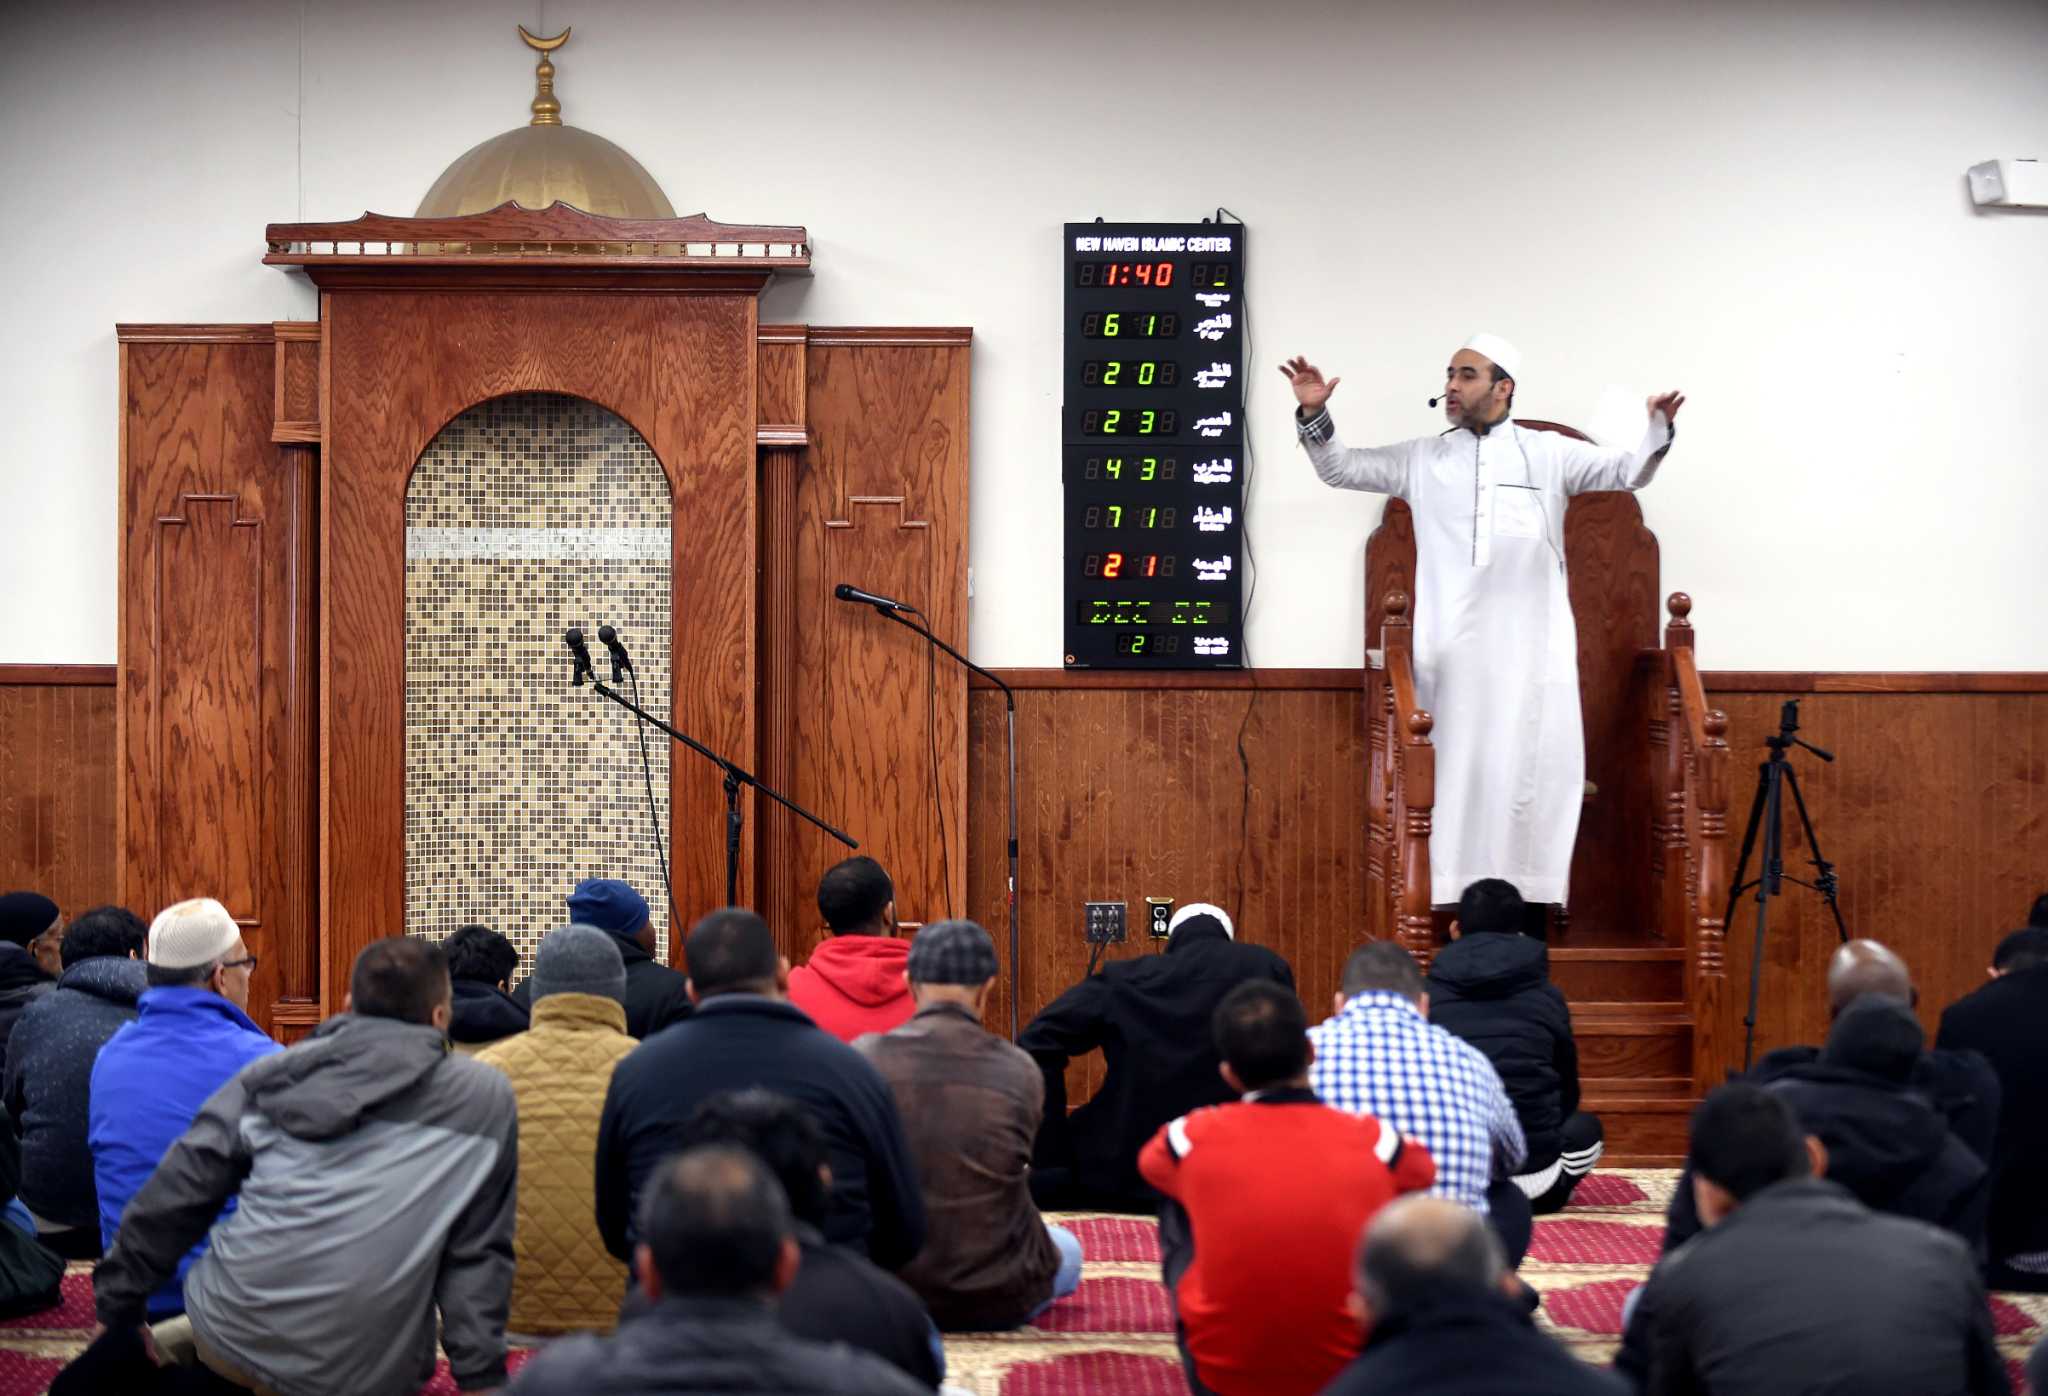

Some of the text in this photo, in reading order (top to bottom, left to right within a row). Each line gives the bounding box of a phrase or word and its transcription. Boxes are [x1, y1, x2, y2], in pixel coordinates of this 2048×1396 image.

[1075, 237, 1232, 252] NEW HAVEN ISLAMIC CENTER
[1108, 263, 1174, 286] 1:40
